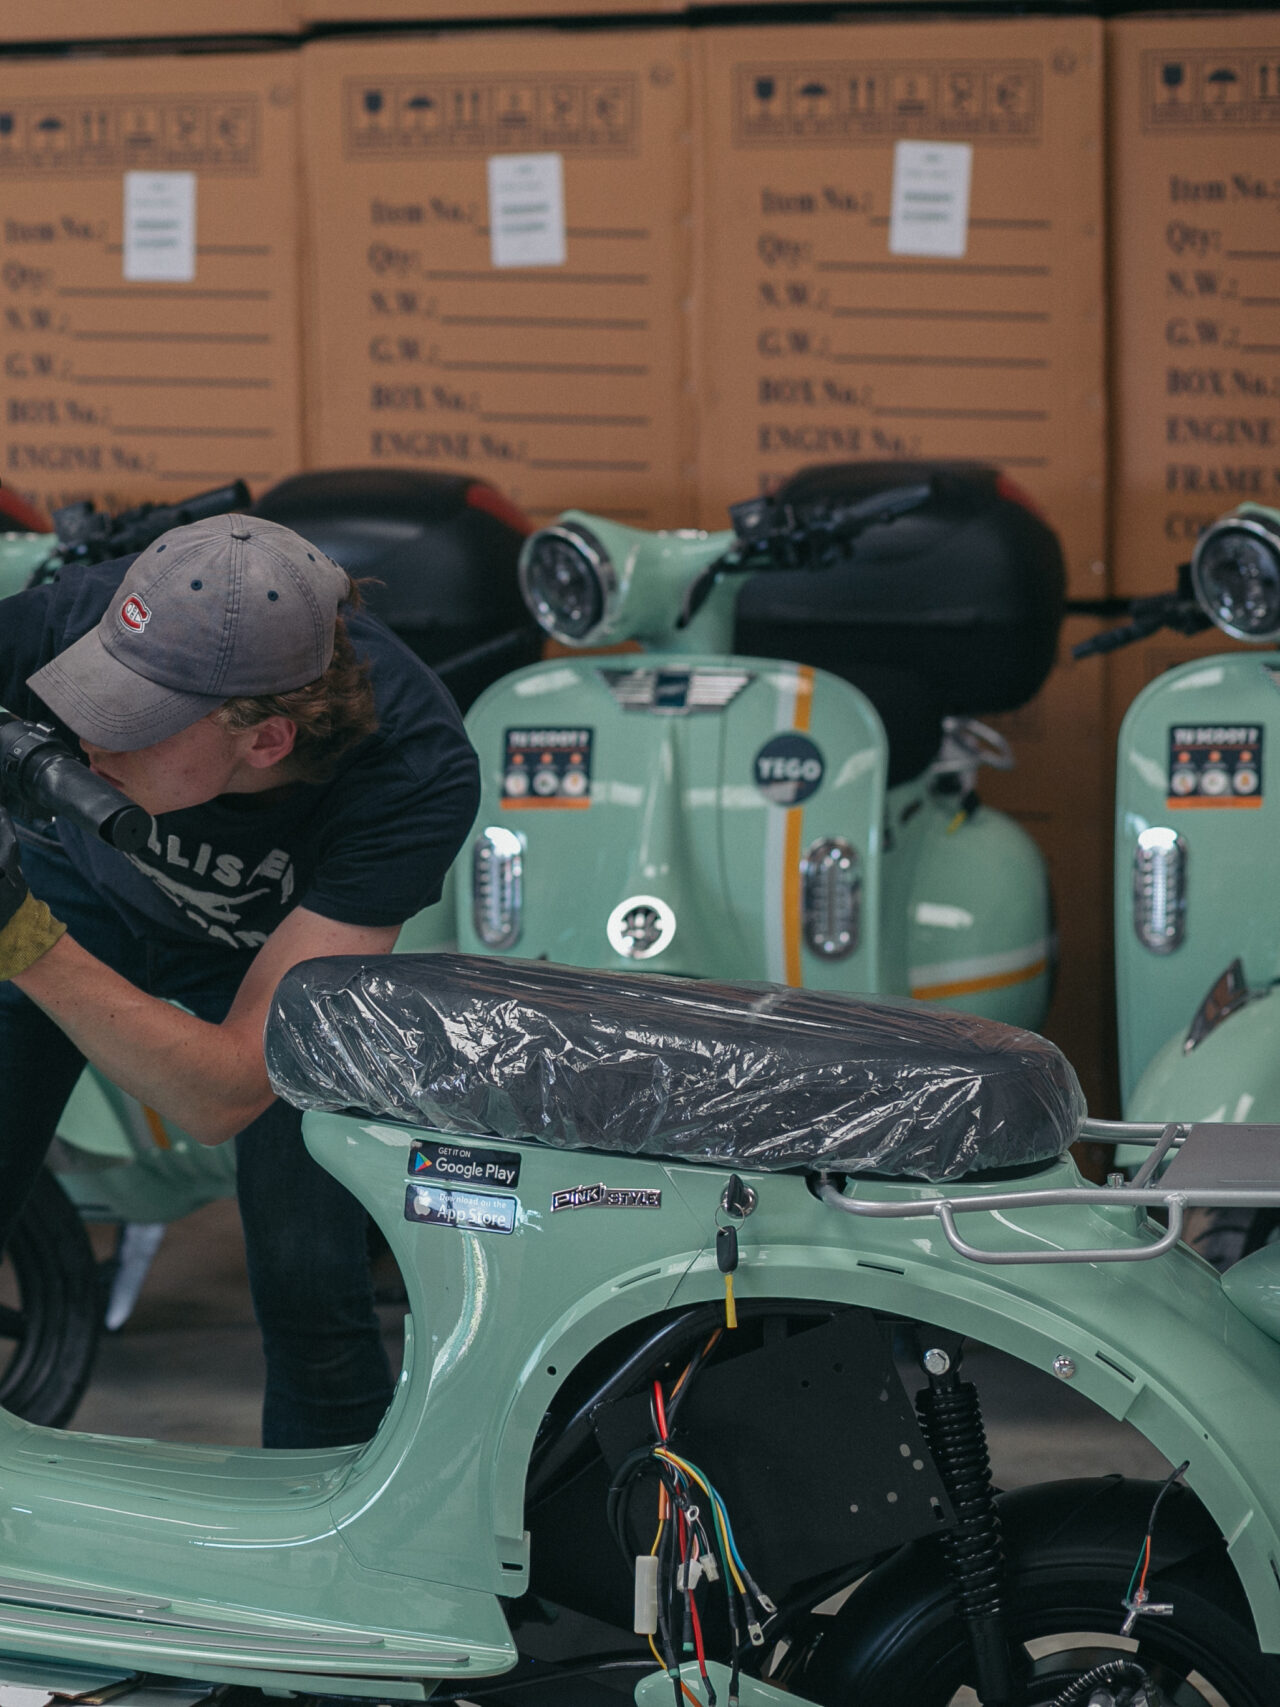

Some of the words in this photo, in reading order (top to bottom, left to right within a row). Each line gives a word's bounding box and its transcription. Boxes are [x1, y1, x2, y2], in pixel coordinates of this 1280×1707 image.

[1169, 174, 1226, 203] Item
[438, 1147, 451, 1156] GET
[453, 1148, 459, 1157] IT
[460, 1149, 471, 1158] ON
[436, 1157, 483, 1178] Google
[485, 1163, 515, 1184] Play
[493, 1200, 507, 1209] the
[554, 1188, 599, 1207] PINK
[607, 1190, 659, 1206] STYLE
[437, 1204, 466, 1222] App
[469, 1208, 506, 1226] Store
